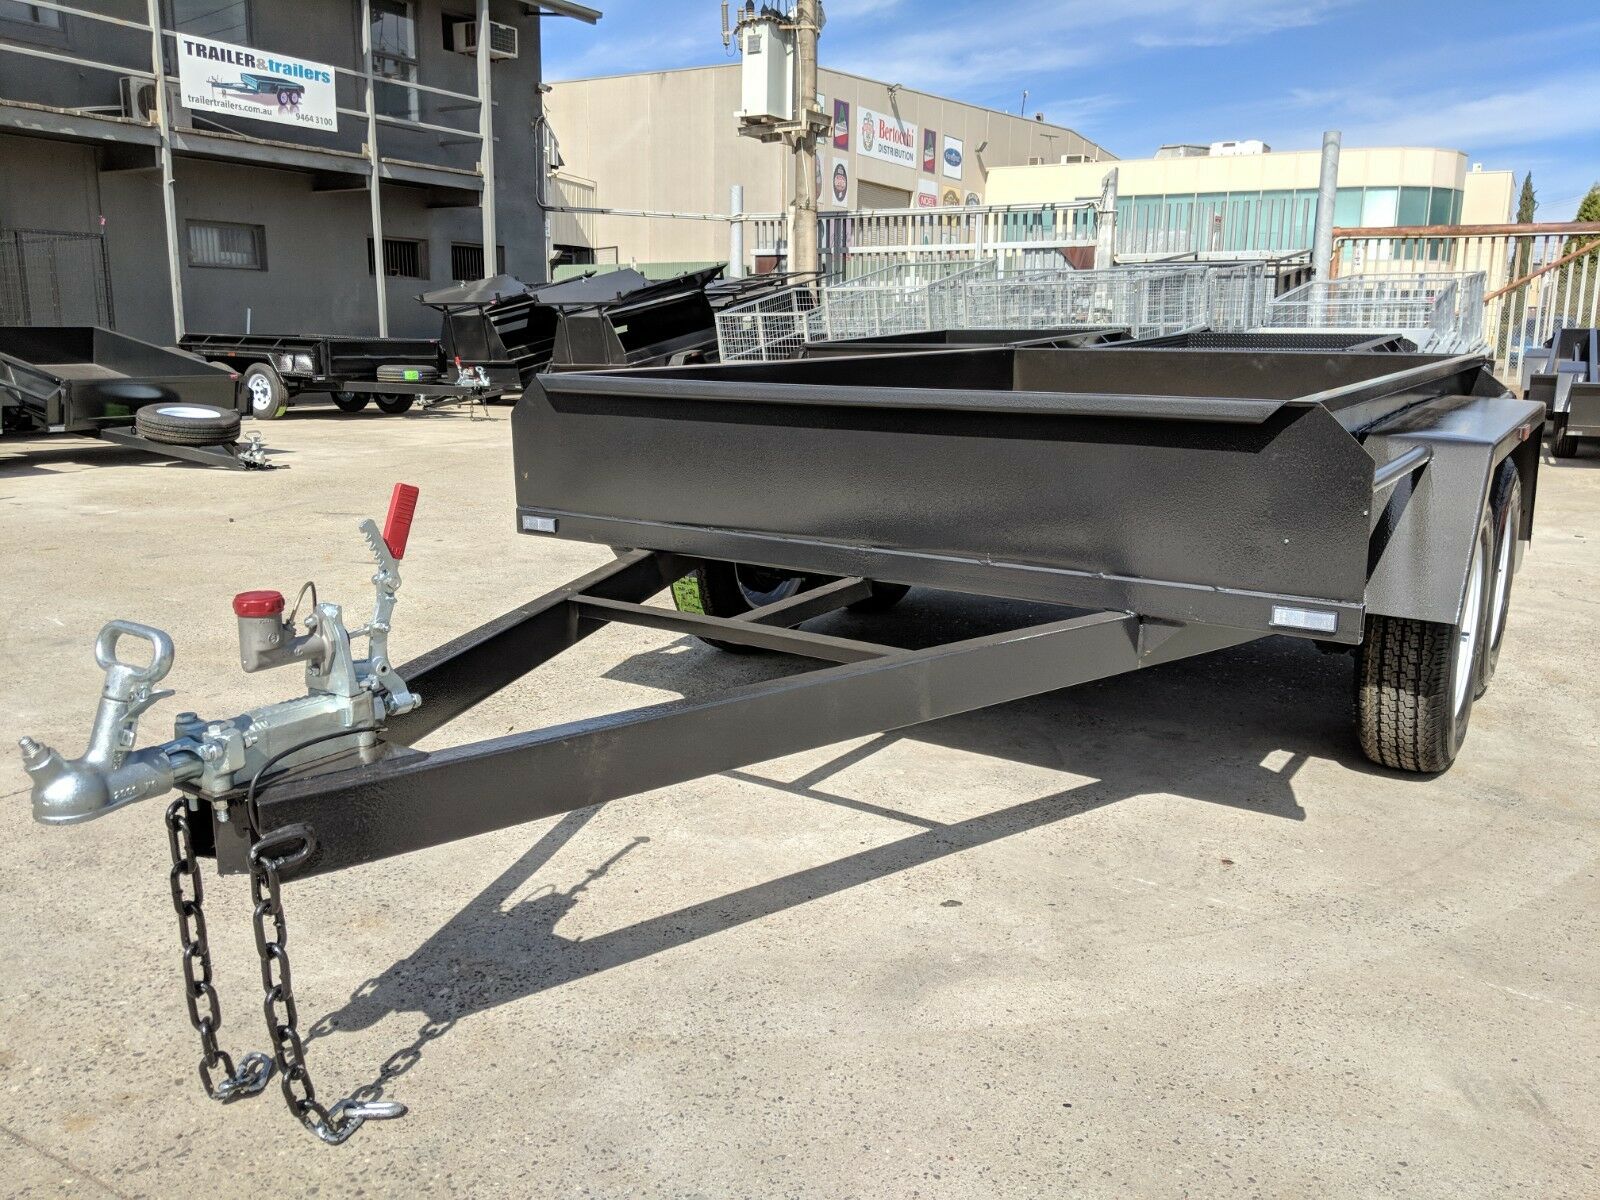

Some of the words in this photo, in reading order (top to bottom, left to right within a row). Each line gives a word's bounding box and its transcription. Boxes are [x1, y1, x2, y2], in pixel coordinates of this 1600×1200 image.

[188, 94, 272, 116] trailertrailers.com.au
[296, 113, 314, 123] 9464
[315, 117, 333, 126] 3100
[878, 143, 914, 161] DISTRIBUTION
